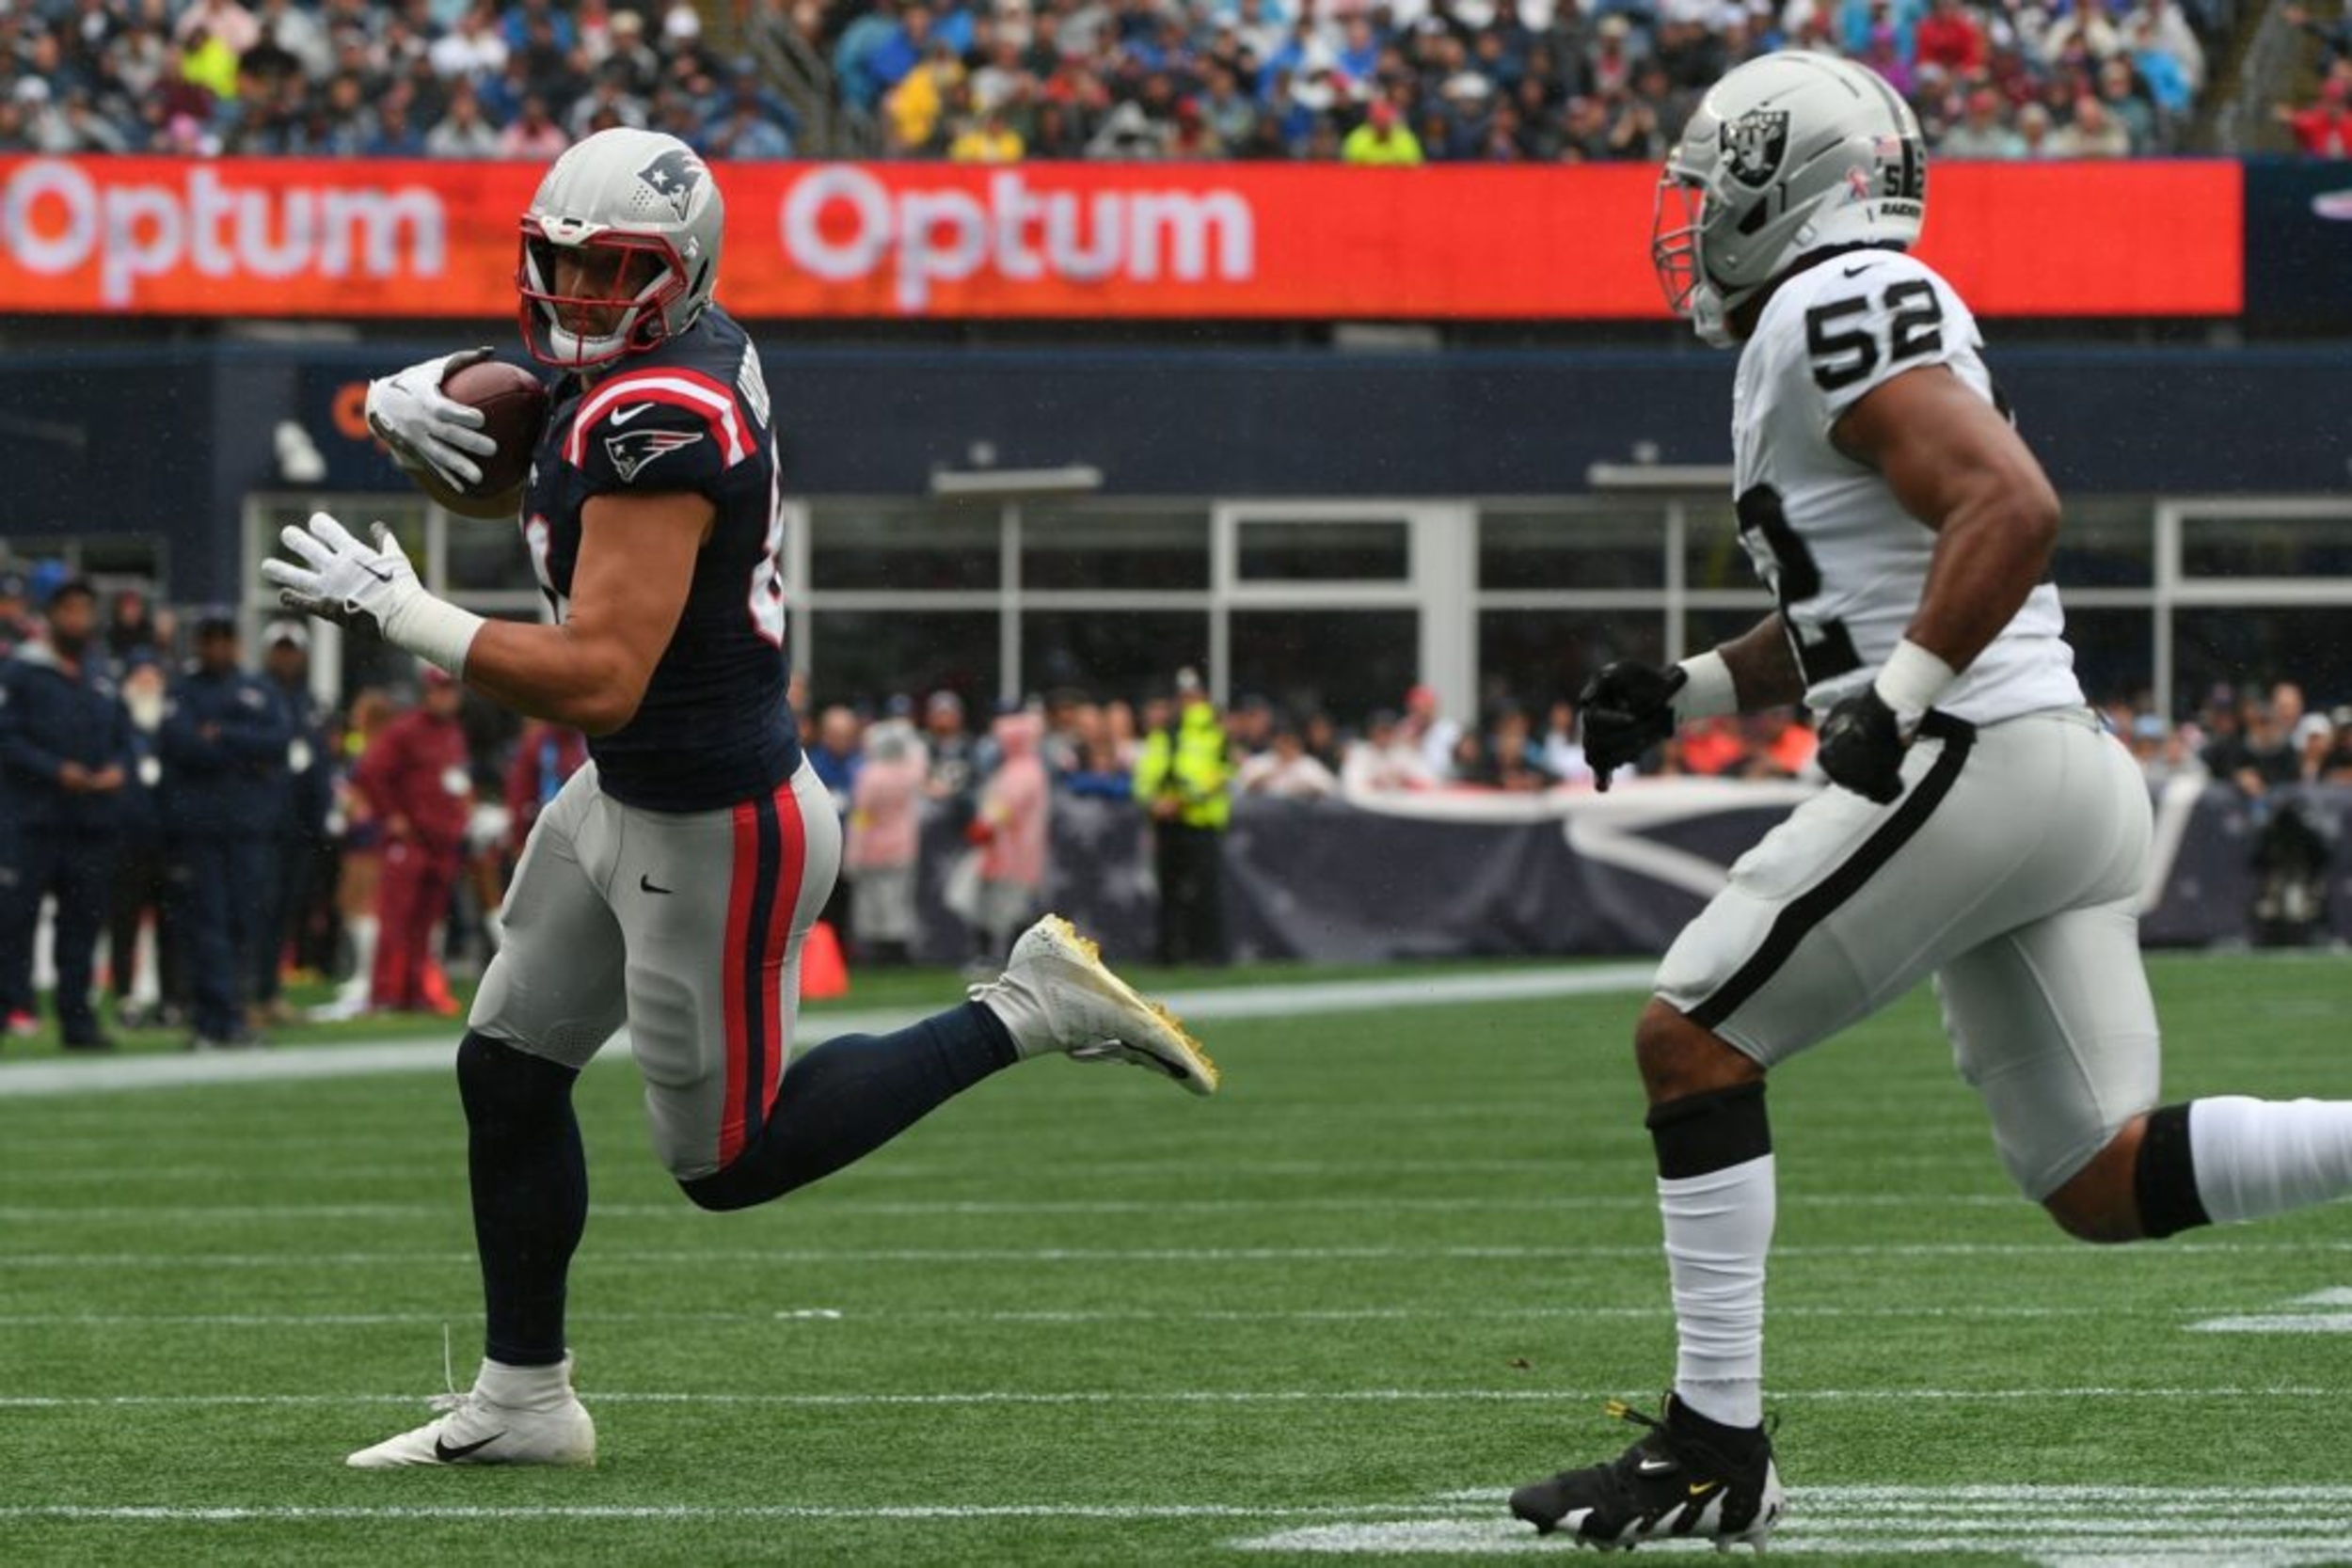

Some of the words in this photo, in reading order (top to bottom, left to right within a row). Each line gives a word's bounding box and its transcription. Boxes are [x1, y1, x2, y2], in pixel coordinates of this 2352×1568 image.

[3, 161, 445, 307] Optum
[781, 164, 1254, 310] Optum
[1806, 279, 1944, 391] 52
